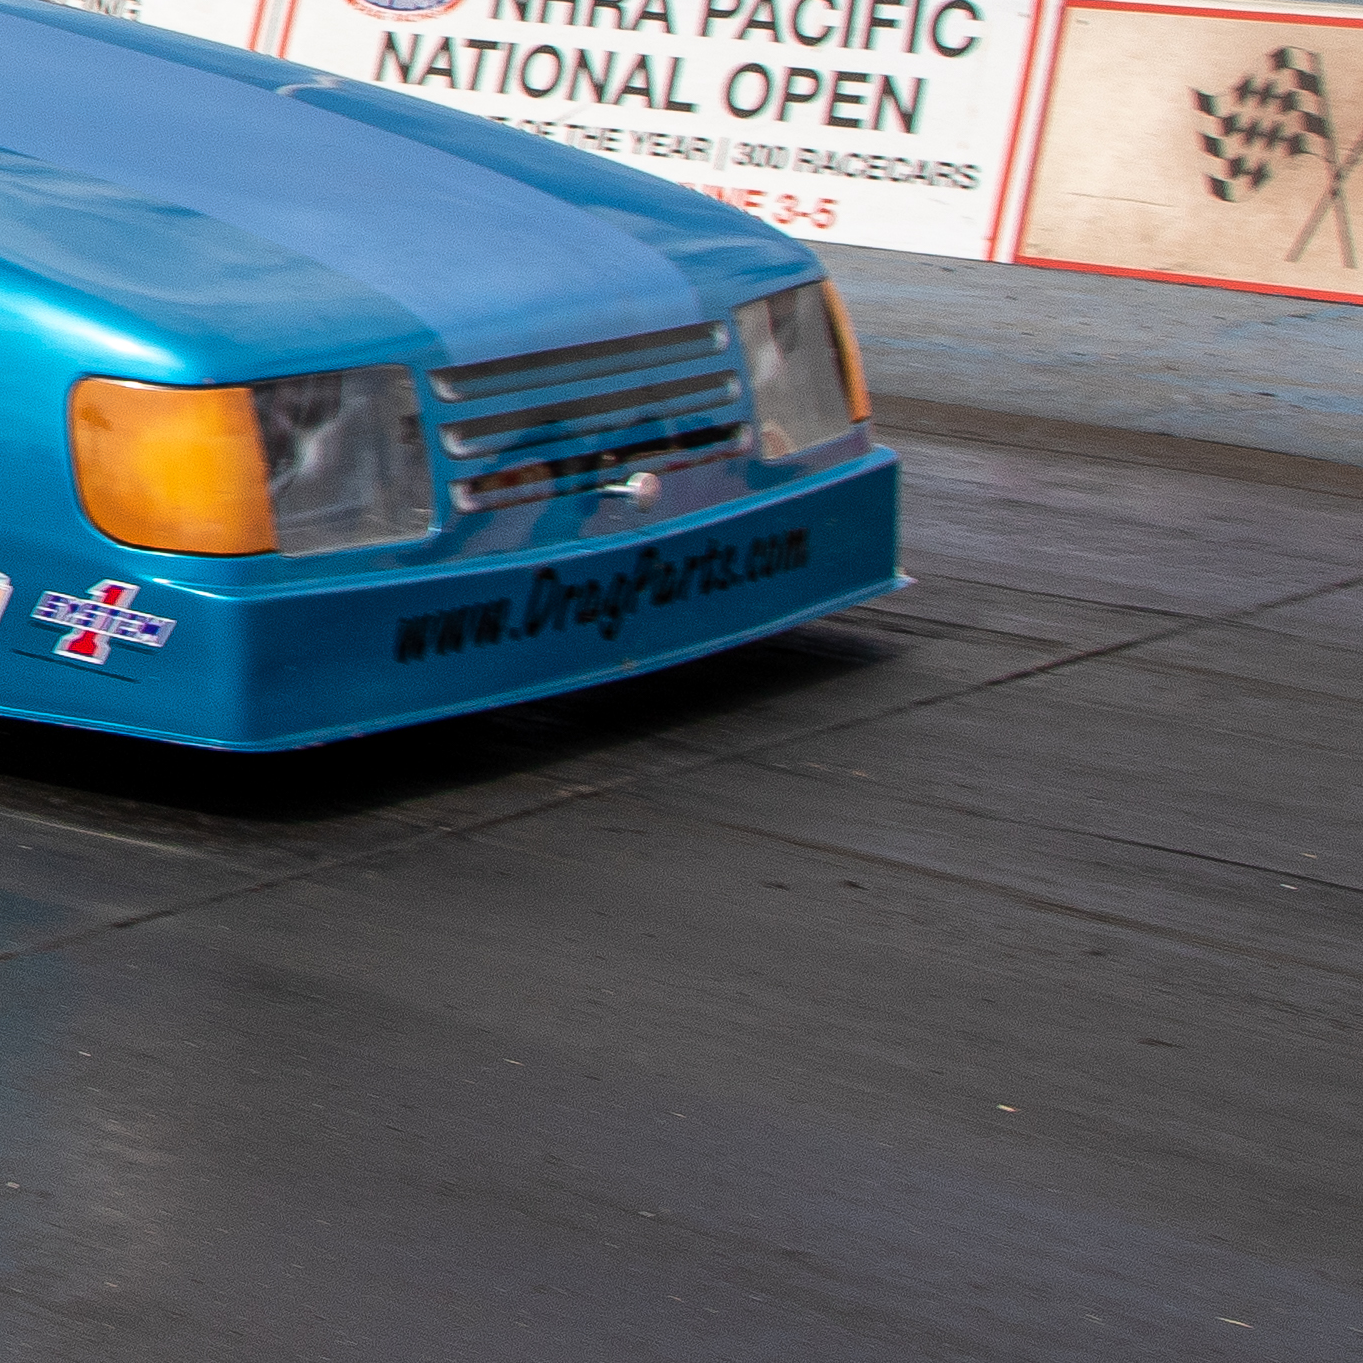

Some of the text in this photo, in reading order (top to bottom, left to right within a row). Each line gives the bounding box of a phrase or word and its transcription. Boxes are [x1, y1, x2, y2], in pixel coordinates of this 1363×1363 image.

[372, 30, 930, 135] NATIONAL OPEN
[564, 124, 623, 153] THE
[628, 130, 714, 162] YEAR
[732, 140, 790, 170] 300
[791, 146, 983, 190] RACECARS
[773, 192, 841, 230] 3-5
[395, 526, 811, 666] www.DragParts.com
